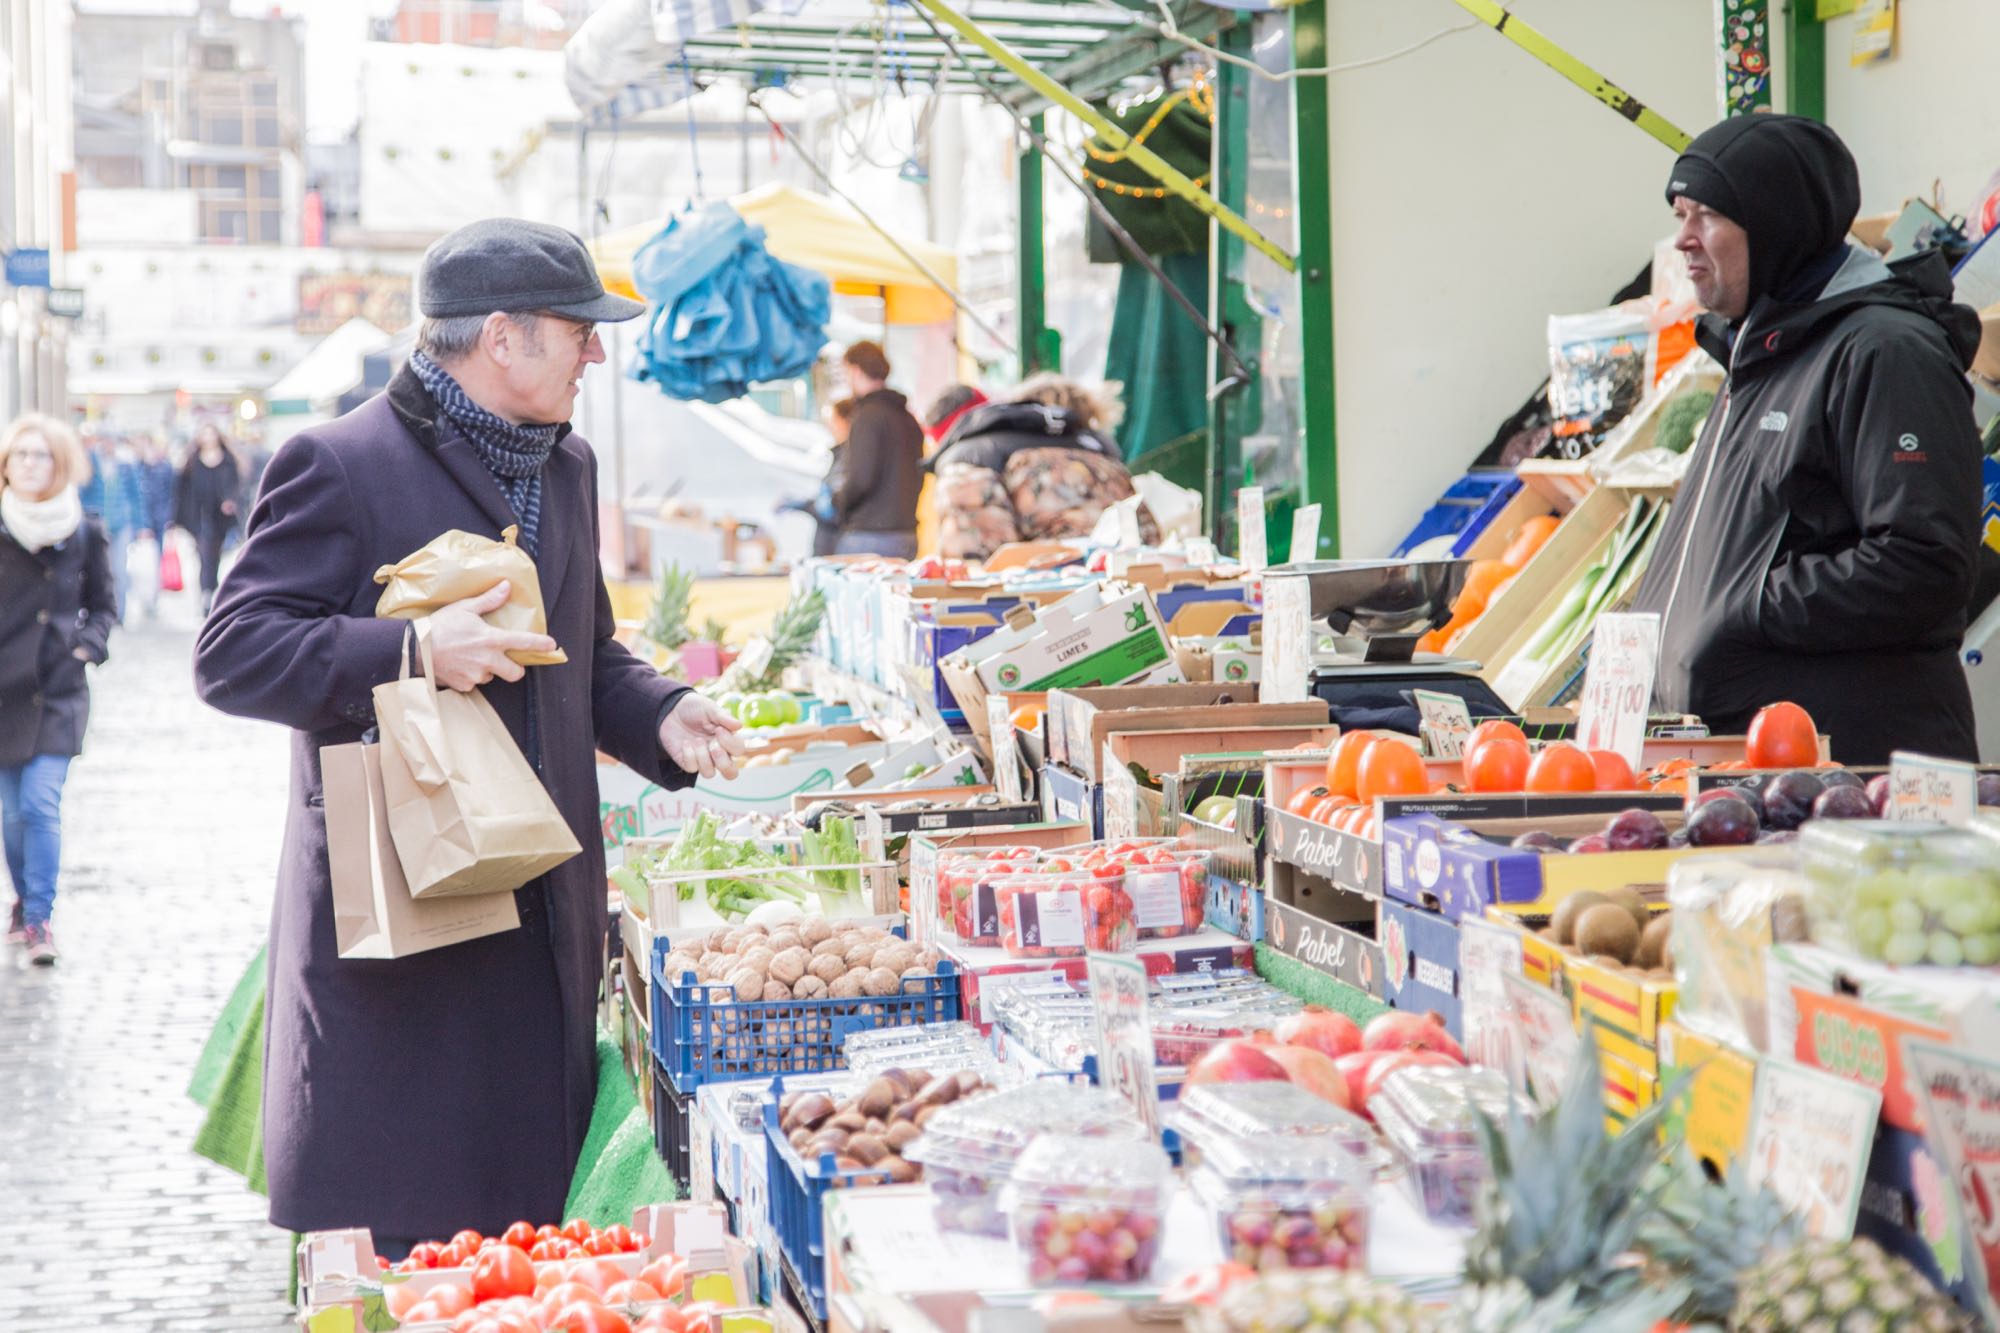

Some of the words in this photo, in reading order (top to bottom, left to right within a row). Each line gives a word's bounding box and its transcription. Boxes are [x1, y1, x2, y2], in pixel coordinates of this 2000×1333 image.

[1056, 641, 1089, 662] LIMES
[1293, 829, 1343, 867] Pabel
[1296, 926, 1345, 967] Pabel
